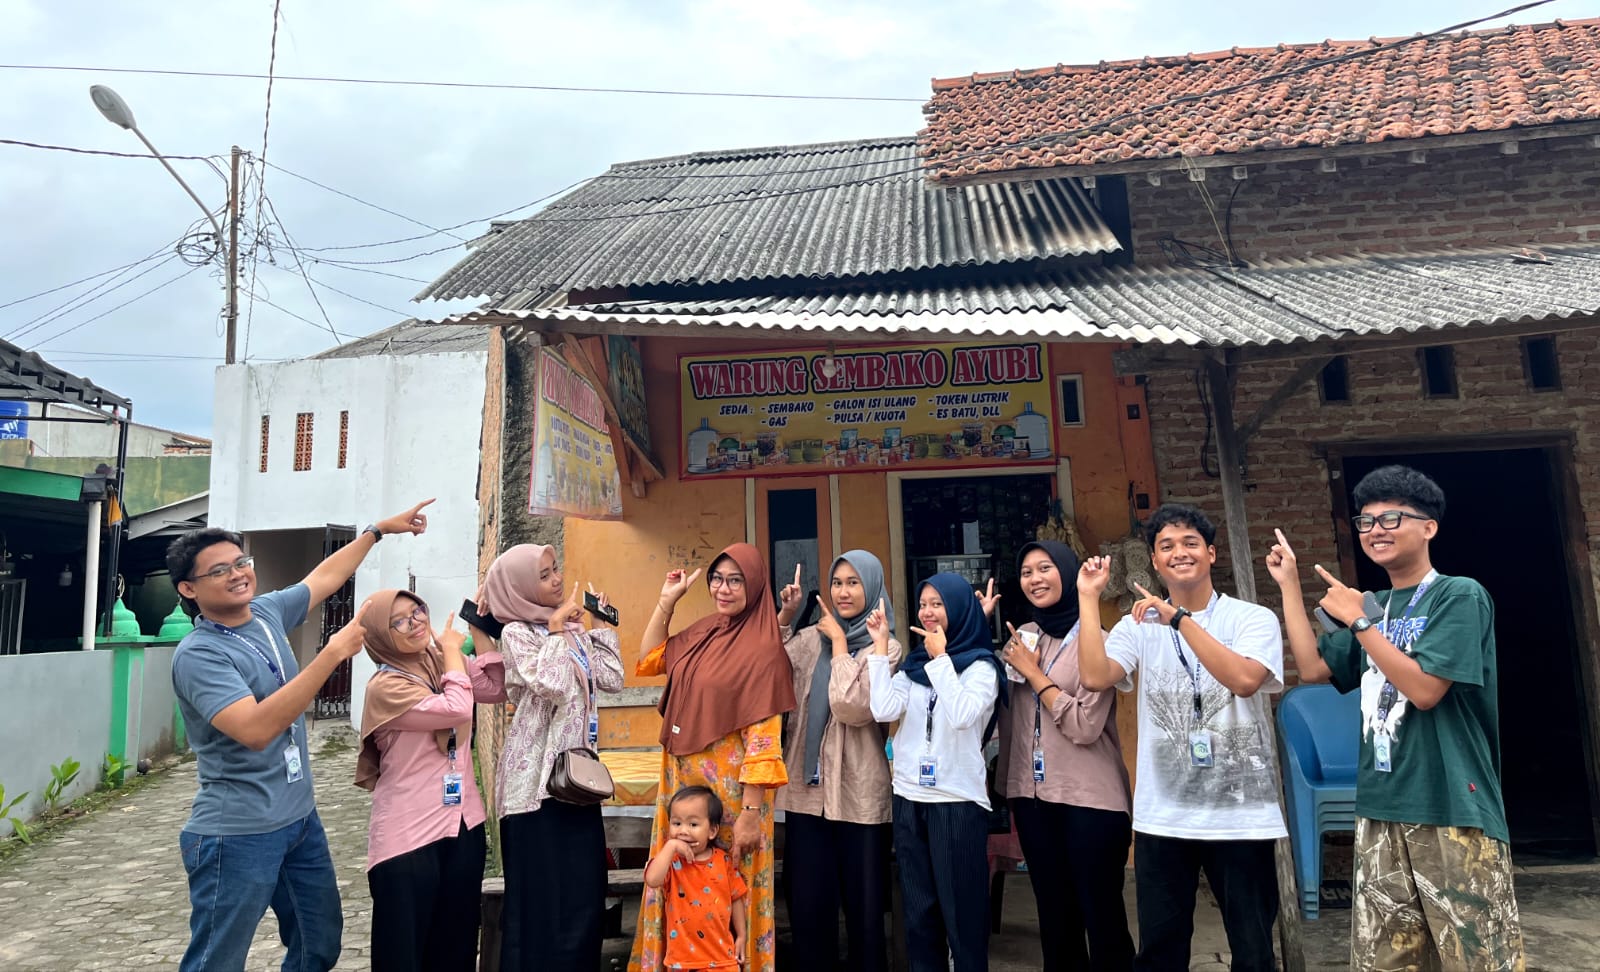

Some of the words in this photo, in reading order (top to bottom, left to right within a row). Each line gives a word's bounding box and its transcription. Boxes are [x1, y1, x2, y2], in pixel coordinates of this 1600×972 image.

[690, 357, 806, 399] WARUNG
[812, 350, 947, 391] SEMBAKO
[952, 345, 1041, 384] AYUBI
[833, 399, 866, 410] GALON
[868, 398, 881, 409] ISI
[884, 396, 916, 407] ULANG
[935, 394, 968, 406] TOKEN
[971, 391, 1010, 403] LISTRIK
[719, 404, 748, 415] SEDIA
[767, 402, 814, 414] SEMBAKO
[936, 408, 949, 419] ES
[982, 406, 1000, 417] DLL
[768, 416, 788, 427] GAS
[834, 412, 864, 424] PULSA
[874, 410, 906, 422] KUOTA
